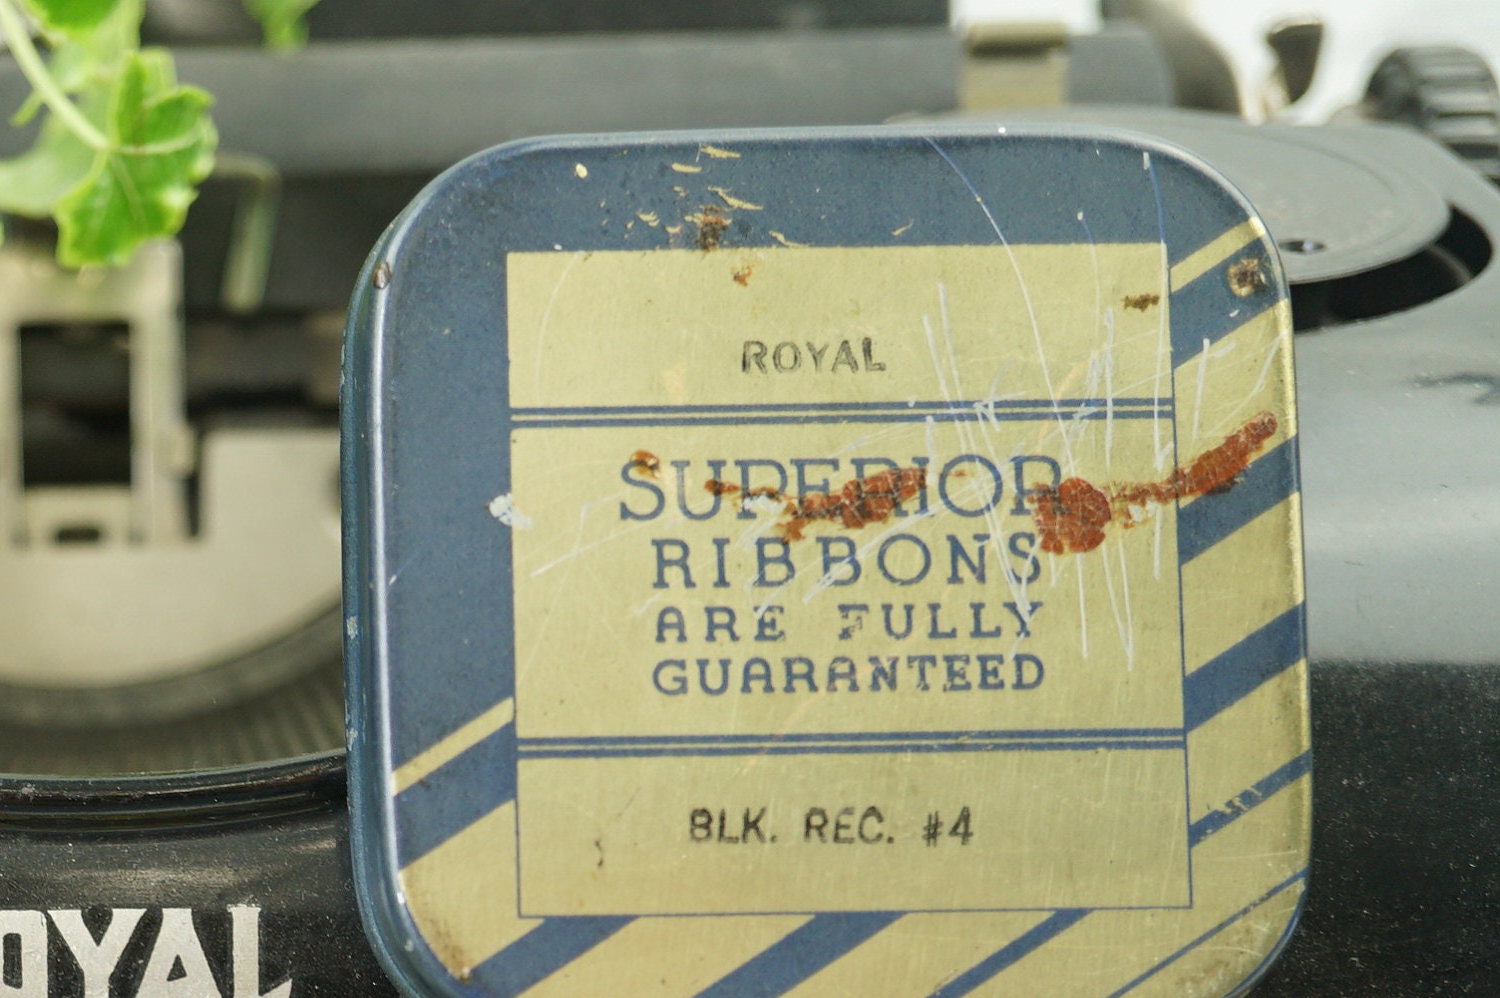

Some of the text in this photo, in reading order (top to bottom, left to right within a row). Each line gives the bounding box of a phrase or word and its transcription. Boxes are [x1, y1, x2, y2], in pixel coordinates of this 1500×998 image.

[741, 338, 888, 375] ROYAL
[651, 531, 1043, 590] RIBBONS
[655, 601, 1044, 643] ARE FULLY
[652, 653, 1045, 696] GUARANTEED
[689, 806, 975, 846] BLK. REC. #4
